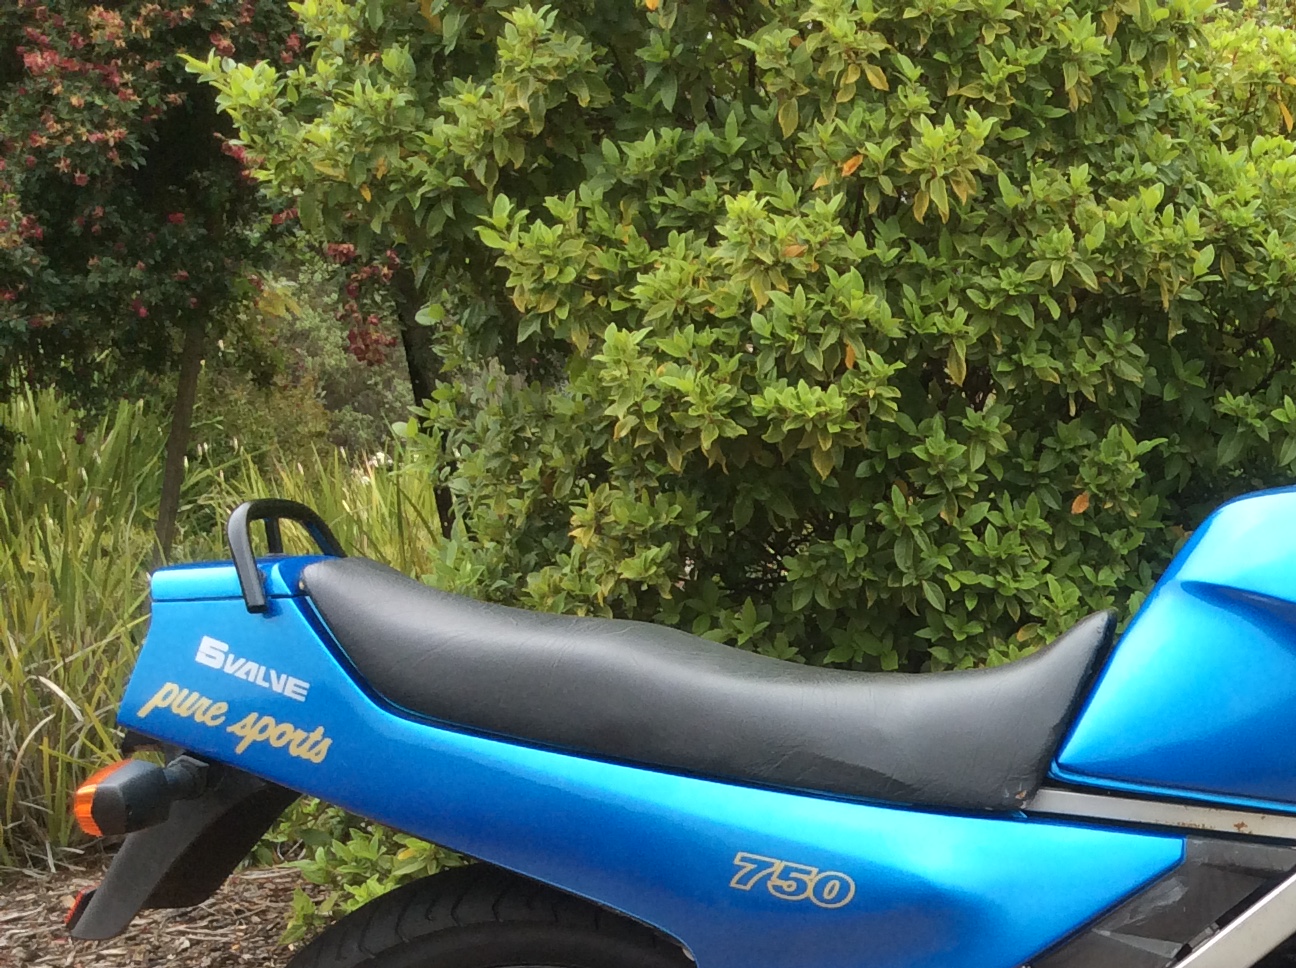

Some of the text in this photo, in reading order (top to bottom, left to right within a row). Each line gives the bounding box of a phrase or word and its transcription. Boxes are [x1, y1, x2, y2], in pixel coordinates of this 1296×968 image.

[137, 682, 333, 763] pure sports
[730, 852, 855, 908] 750
